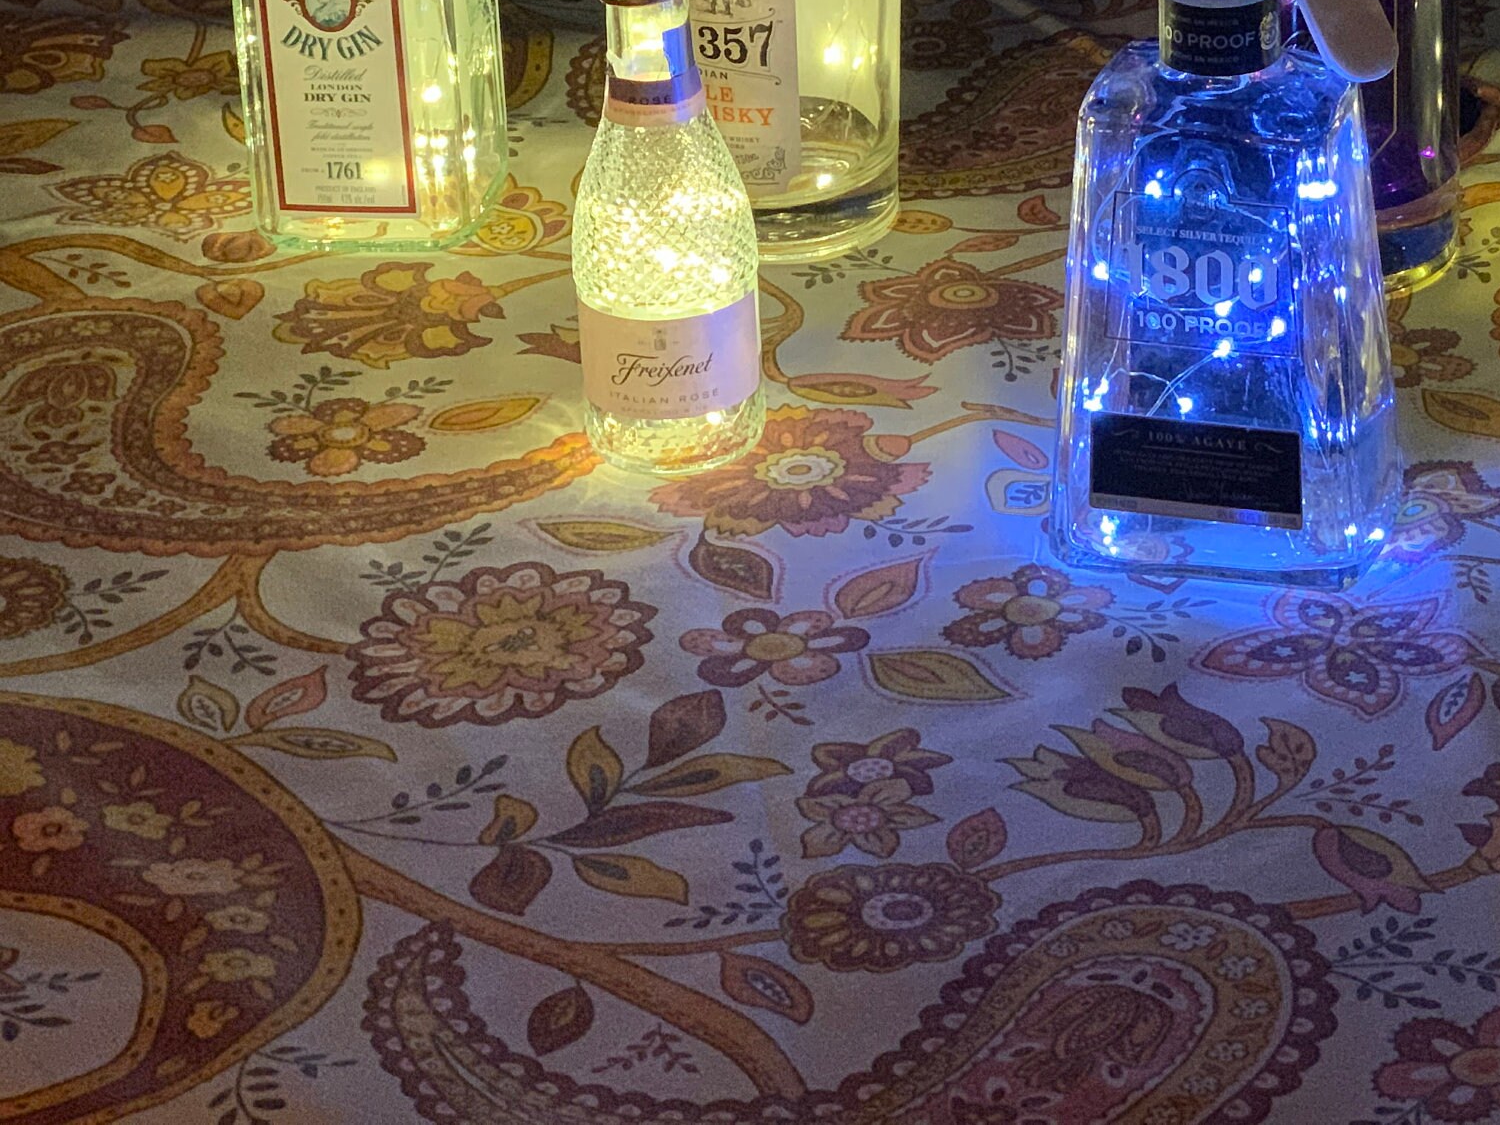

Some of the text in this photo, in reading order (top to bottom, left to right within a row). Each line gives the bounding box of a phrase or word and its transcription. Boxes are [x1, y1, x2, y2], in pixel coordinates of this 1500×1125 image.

[281, 25, 384, 62] DRY GIN
[1187, 31, 1256, 50] PROOF
[310, 83, 363, 91] LONDON
[304, 92, 372, 103] DRY GIN
[326, 161, 364, 180] 1761
[1136, 225, 1178, 238] SELECT
[1179, 228, 1218, 242] SILVER
[1120, 241, 1279, 311] 1800
[1184, 315, 1268, 336] PROOF
[611, 352, 714, 387] Freixenet
[609, 391, 670, 405] ITALIAN
[1194, 435, 1247, 451] AGAVE
